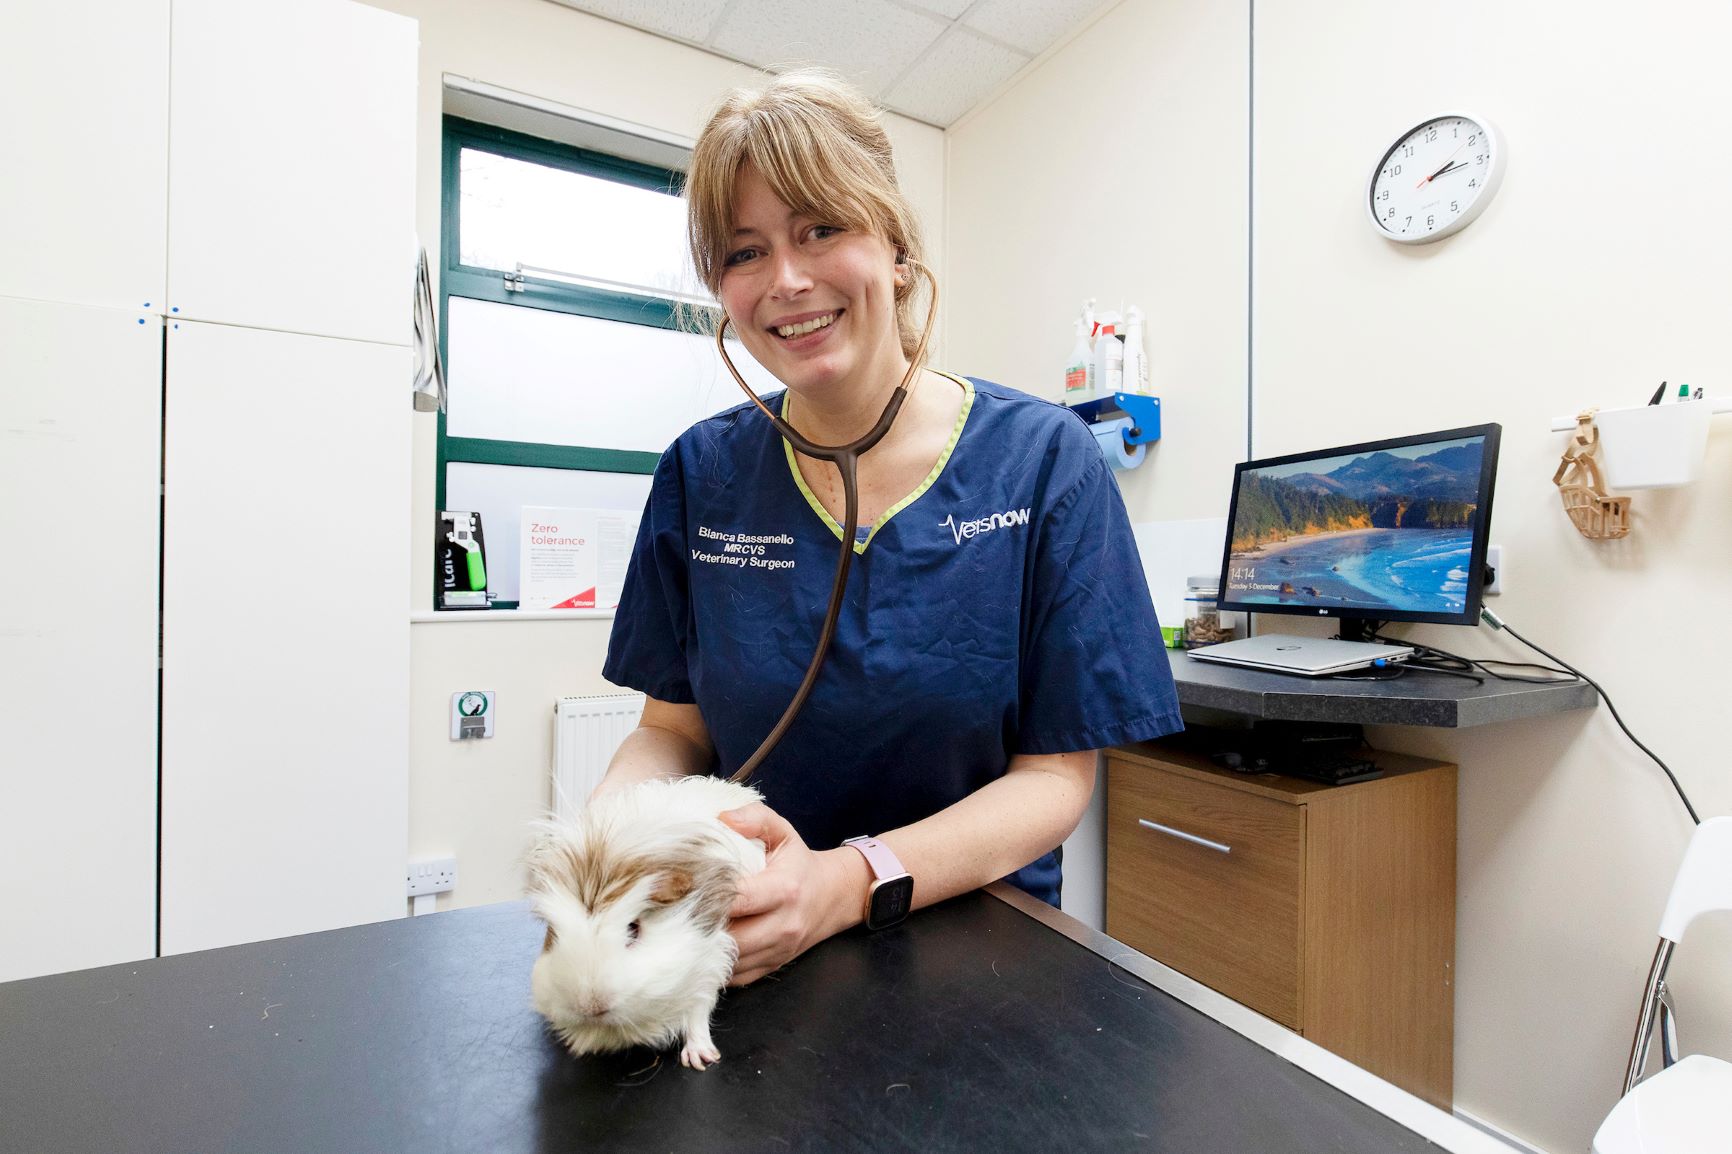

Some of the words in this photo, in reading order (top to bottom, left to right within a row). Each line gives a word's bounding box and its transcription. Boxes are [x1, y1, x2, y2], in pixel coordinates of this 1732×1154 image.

[1425, 129, 1438, 143] 12
[1468, 135, 1476, 147] 2
[1404, 146, 1414, 158] 11
[1476, 154, 1484, 165] 3
[1389, 164, 1402, 178] 10
[1468, 178, 1476, 189] 4
[1382, 190, 1390, 201] 9
[1450, 201, 1458, 212] 5
[1388, 207, 1396, 218] 8
[1405, 216, 1413, 227] 7
[1427, 215, 1435, 226] 6
[531, 523, 558, 533] Zero
[938, 507, 1031, 545] Vetsnow
[531, 536, 585, 545] tolerance
[698, 526, 735, 542] Bianca
[737, 533, 794, 545] Bassanello
[724, 543, 765, 555] MRCVS
[691, 549, 747, 567] Veterinary
[749, 557, 795, 570] Surgeon
[1231, 567, 1255, 580] 14:14
[1228, 582, 1247, 591] Tuesday
[1253, 583, 1279, 591] December
